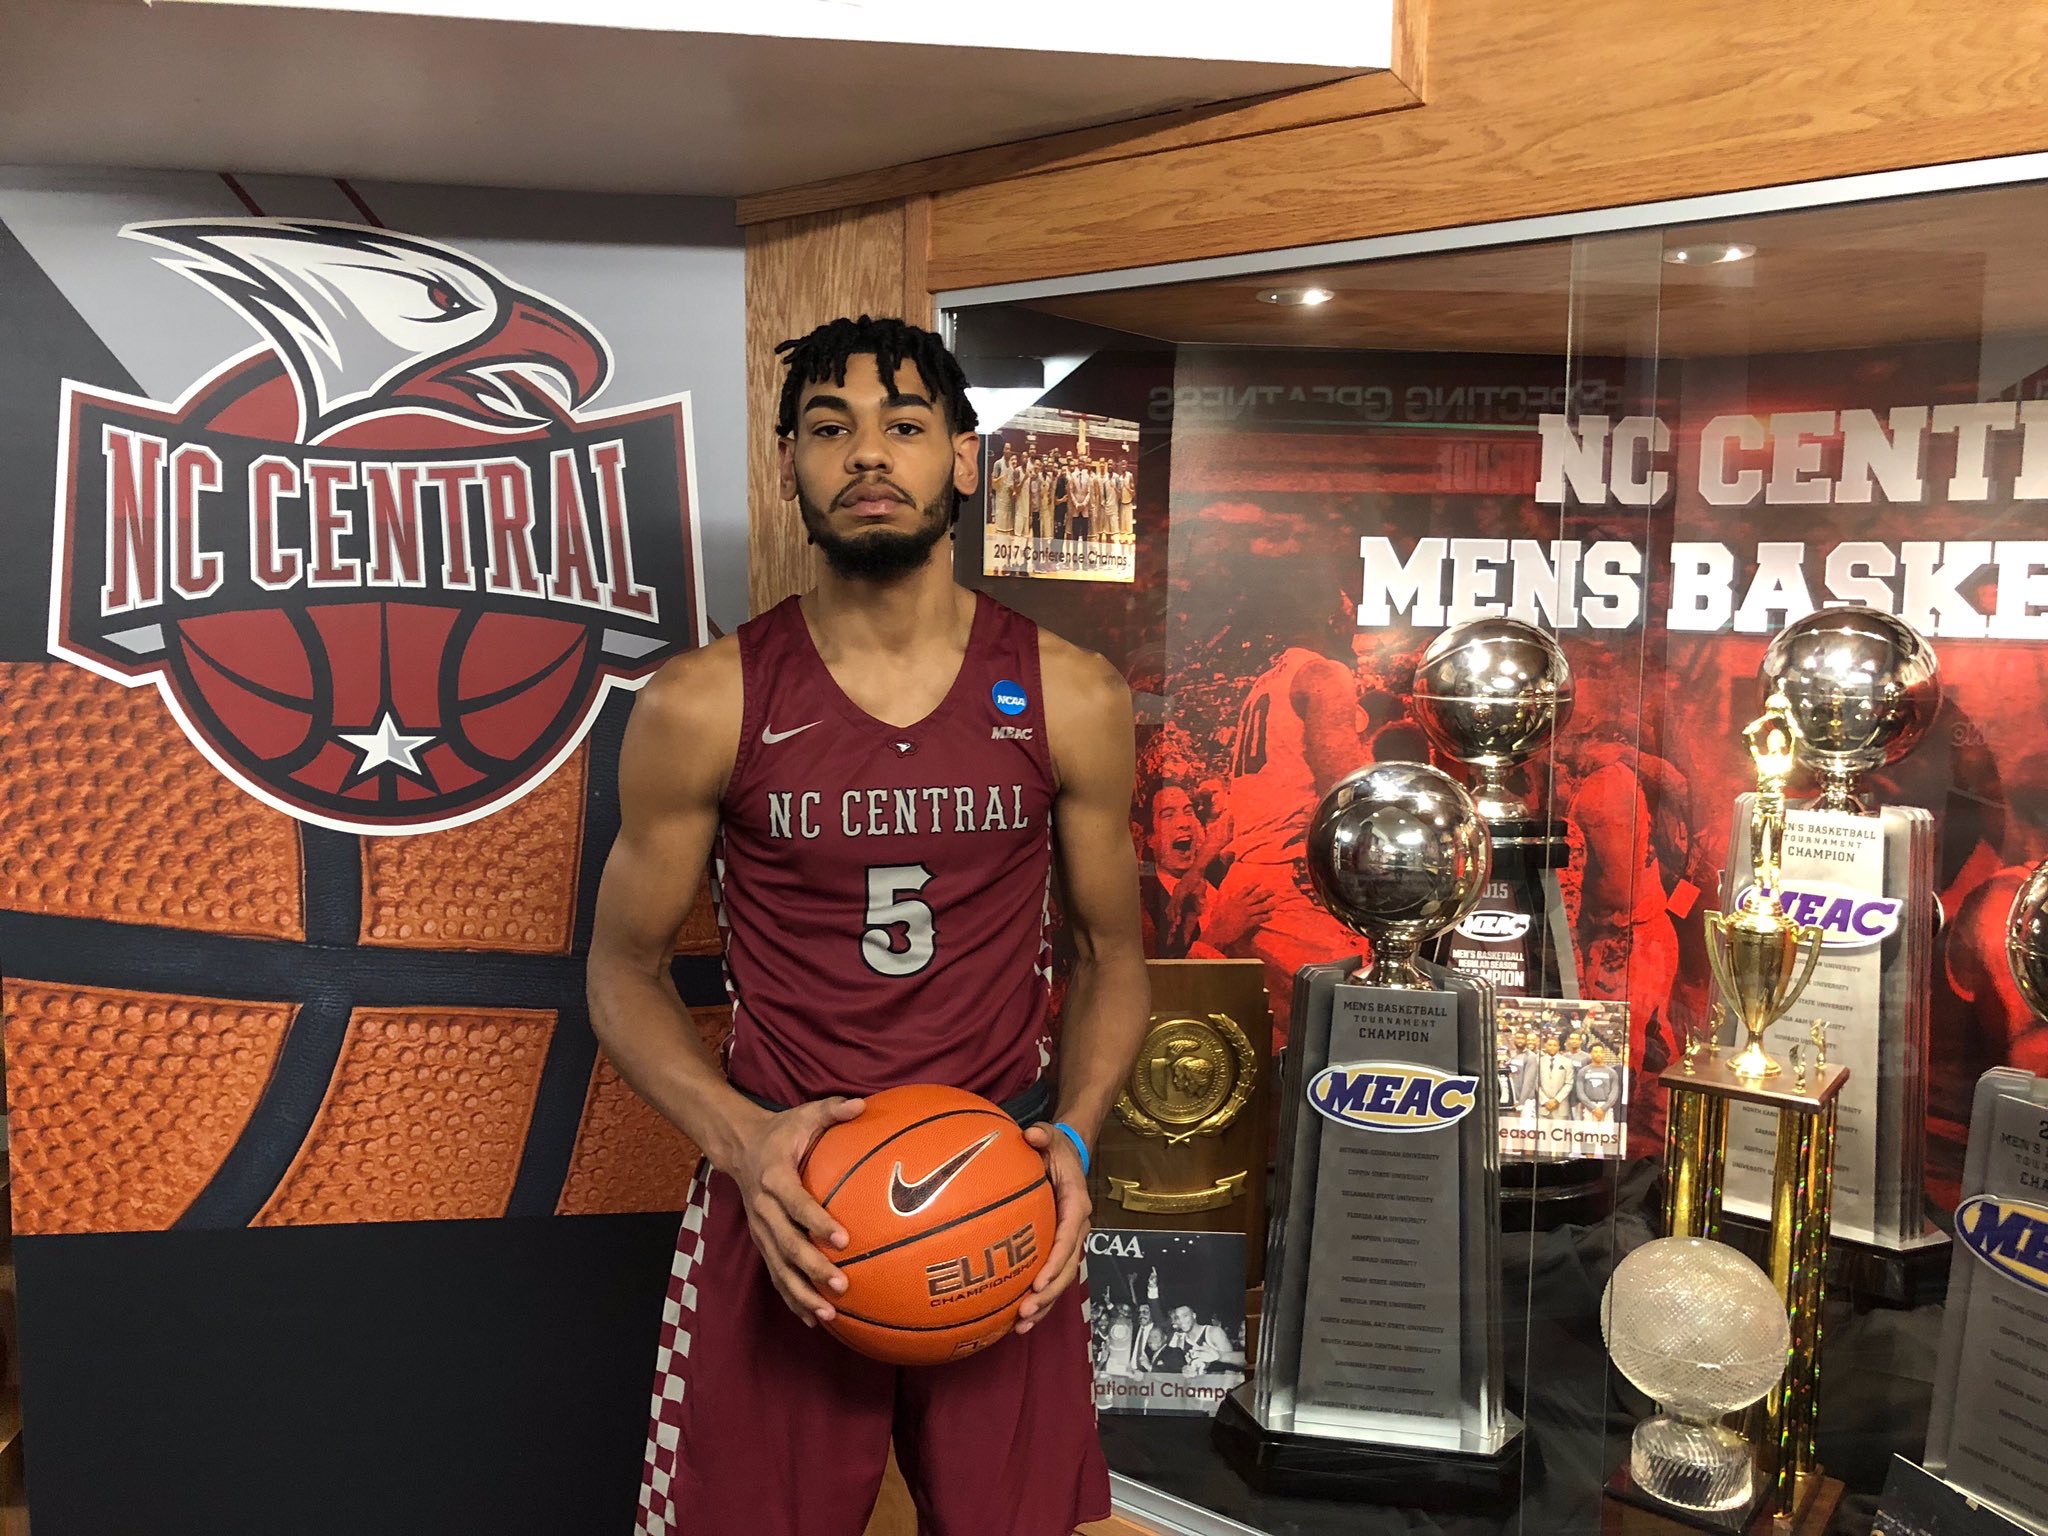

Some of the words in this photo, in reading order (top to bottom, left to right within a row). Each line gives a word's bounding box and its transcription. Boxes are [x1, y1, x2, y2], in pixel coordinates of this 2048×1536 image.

[1535, 413, 1671, 505] NC
[101, 423, 224, 617] NC
[247, 437, 659, 625] CENTRAL
[994, 544, 1020, 560] 2017
[1023, 546, 1085, 565] Conference
[1357, 536, 1642, 629] MENS
[1667, 540, 2048, 640] BASKE
[997, 694, 1026, 706] NCAA
[991, 726, 1034, 740] MEAC
[768, 791, 821, 839] NC
[840, 784, 1029, 838] CENTRAL
[1808, 825, 1876, 840] BASKETBALL
[1784, 834, 1862, 849] TOURNAMENT
[1788, 846, 1855, 862] CHAMPION
[860, 862, 938, 979] 5
[1477, 951, 1525, 962] BASKETBALL
[1377, 1003, 1448, 1017] BASKETBALL
[1354, 1014, 1436, 1028] TOURNAMENT
[1359, 1028, 1430, 1043] CHAMPION
[1326, 1071, 1475, 1118] MEAC
[1499, 1127, 1546, 1142] eason
[1550, 1128, 1619, 1145] Champs
[925, 1222, 1038, 1297] ELITE
[930, 1254, 1039, 1308] CHAMPIONSHIP
[1095, 1381, 1155, 1397] ational
